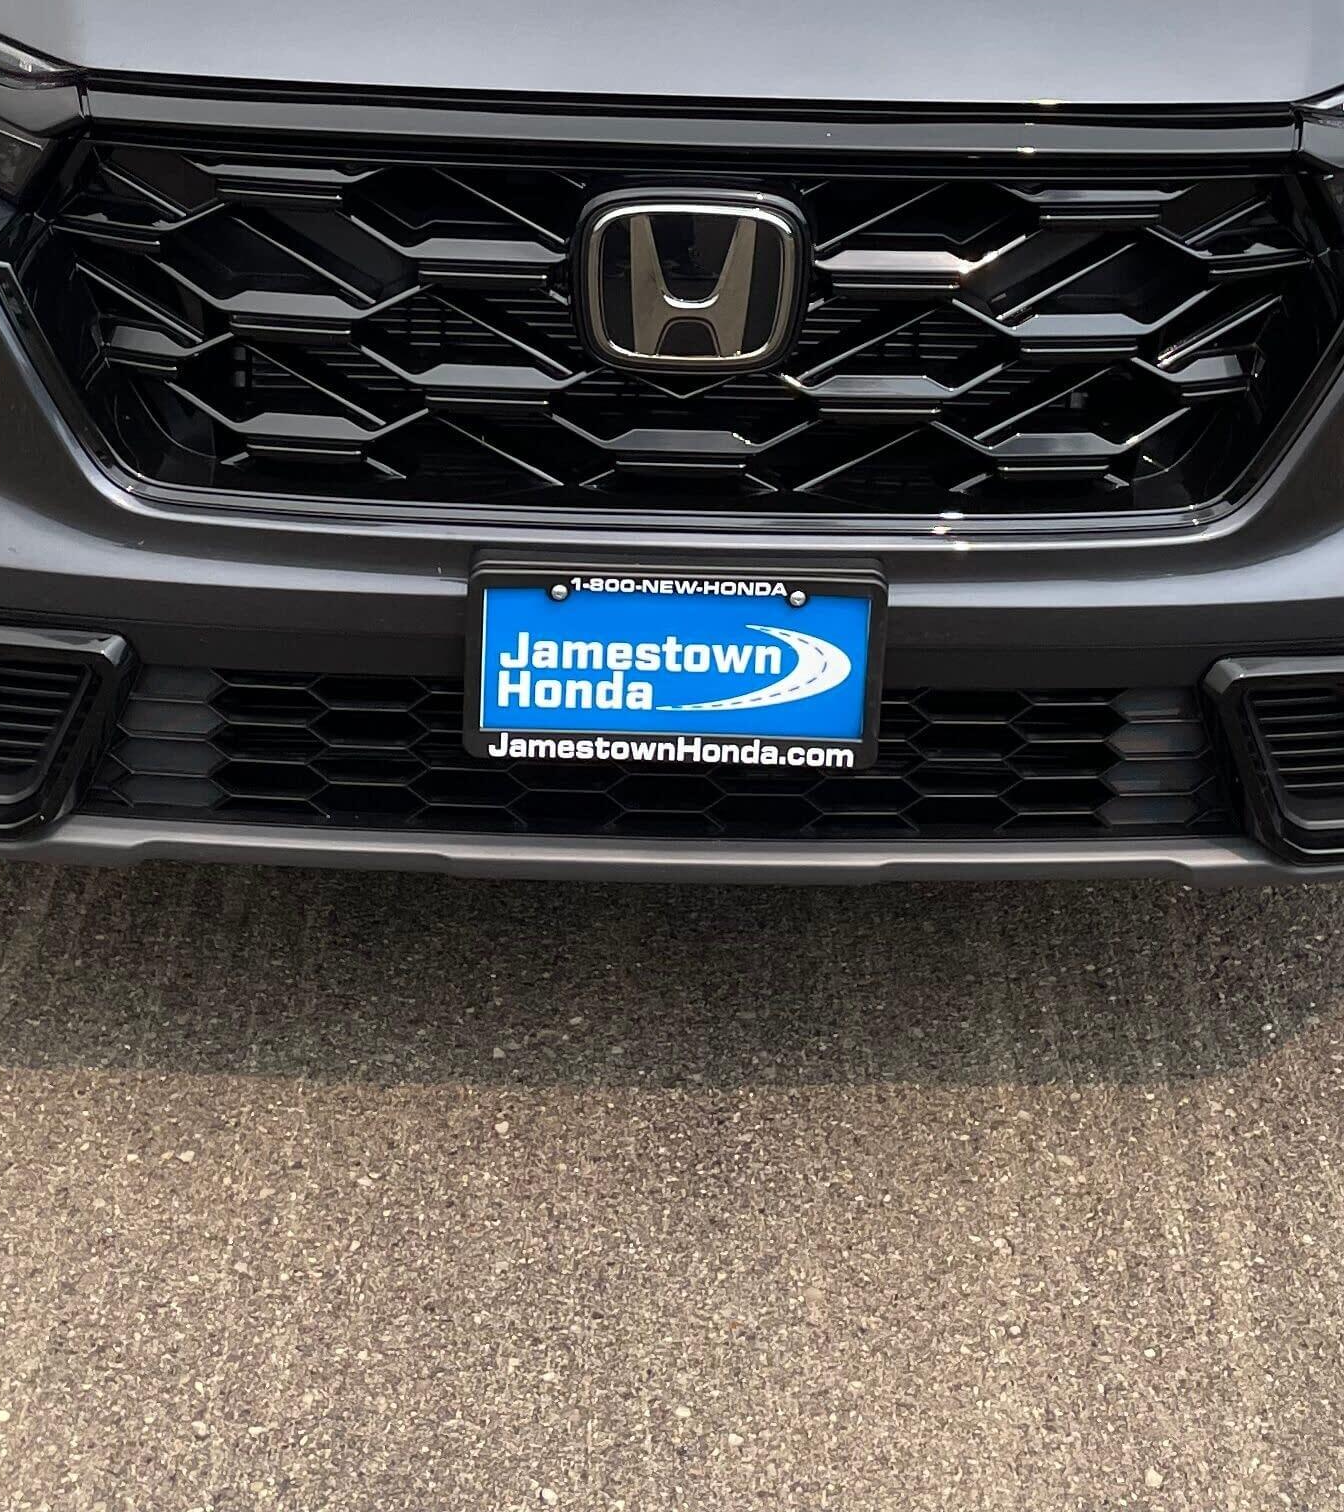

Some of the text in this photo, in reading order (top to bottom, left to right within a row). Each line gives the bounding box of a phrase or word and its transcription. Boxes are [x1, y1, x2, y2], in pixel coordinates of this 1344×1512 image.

[570, 577, 788, 597] 1-800-NEW-HONDA
[499, 631, 782, 675] Jamestown
[497, 670, 654, 711] Honda
[488, 732, 855, 768] JamestownHonda.com
